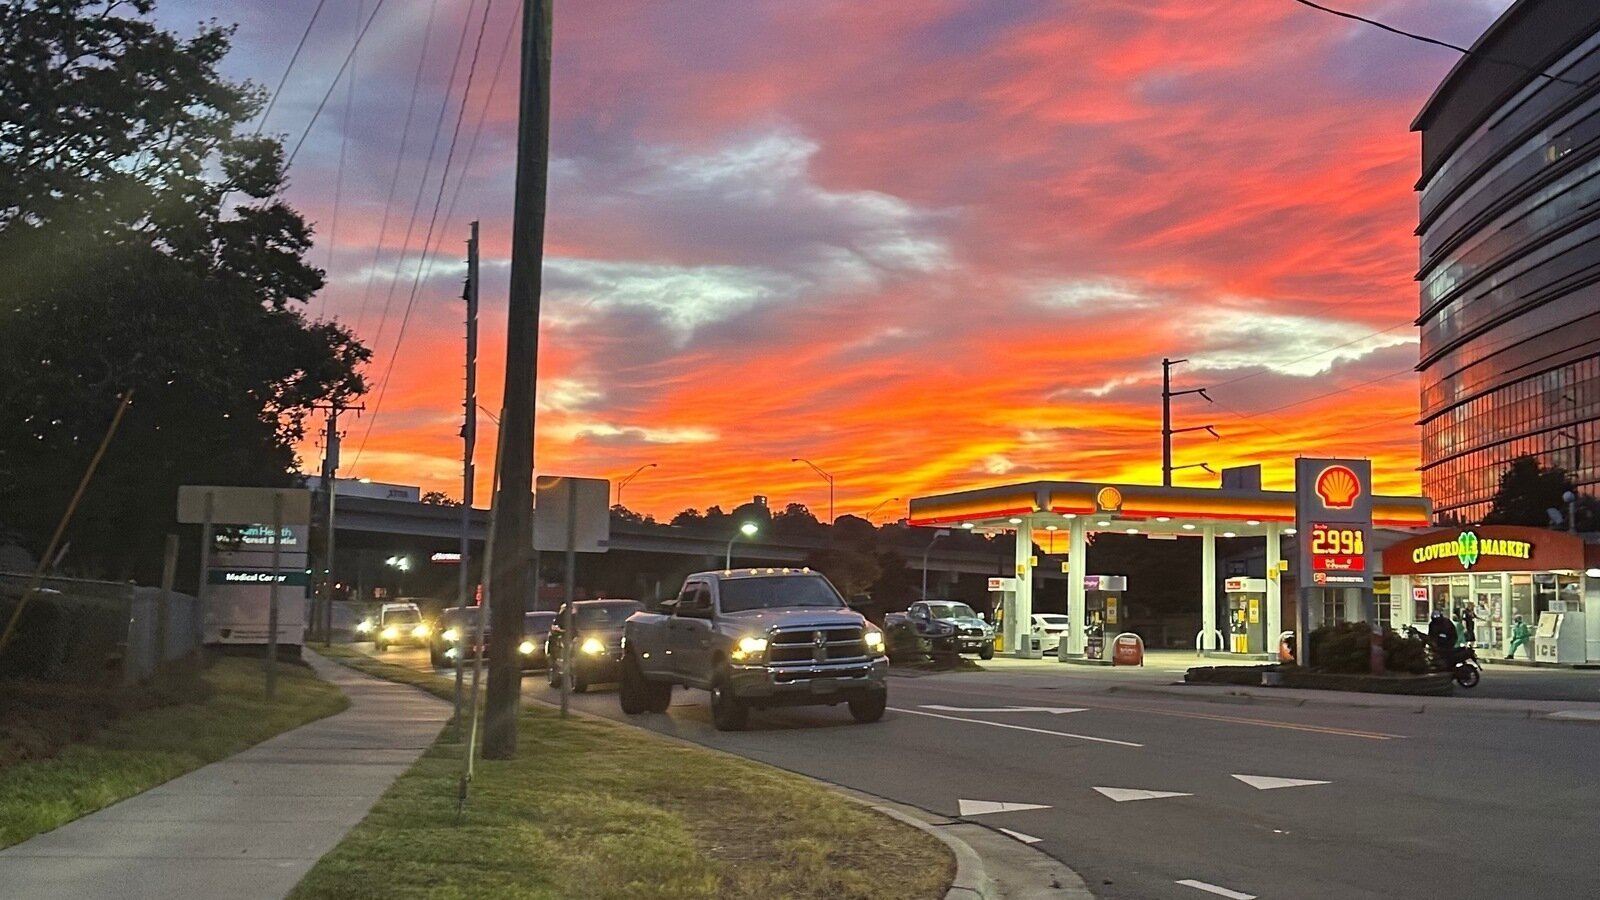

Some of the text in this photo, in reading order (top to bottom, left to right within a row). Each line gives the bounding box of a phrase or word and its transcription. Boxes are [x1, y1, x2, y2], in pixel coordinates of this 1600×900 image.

[1412, 539, 1530, 563] CLOVERDALE MARKET
[1536, 644, 1556, 657] ICE
